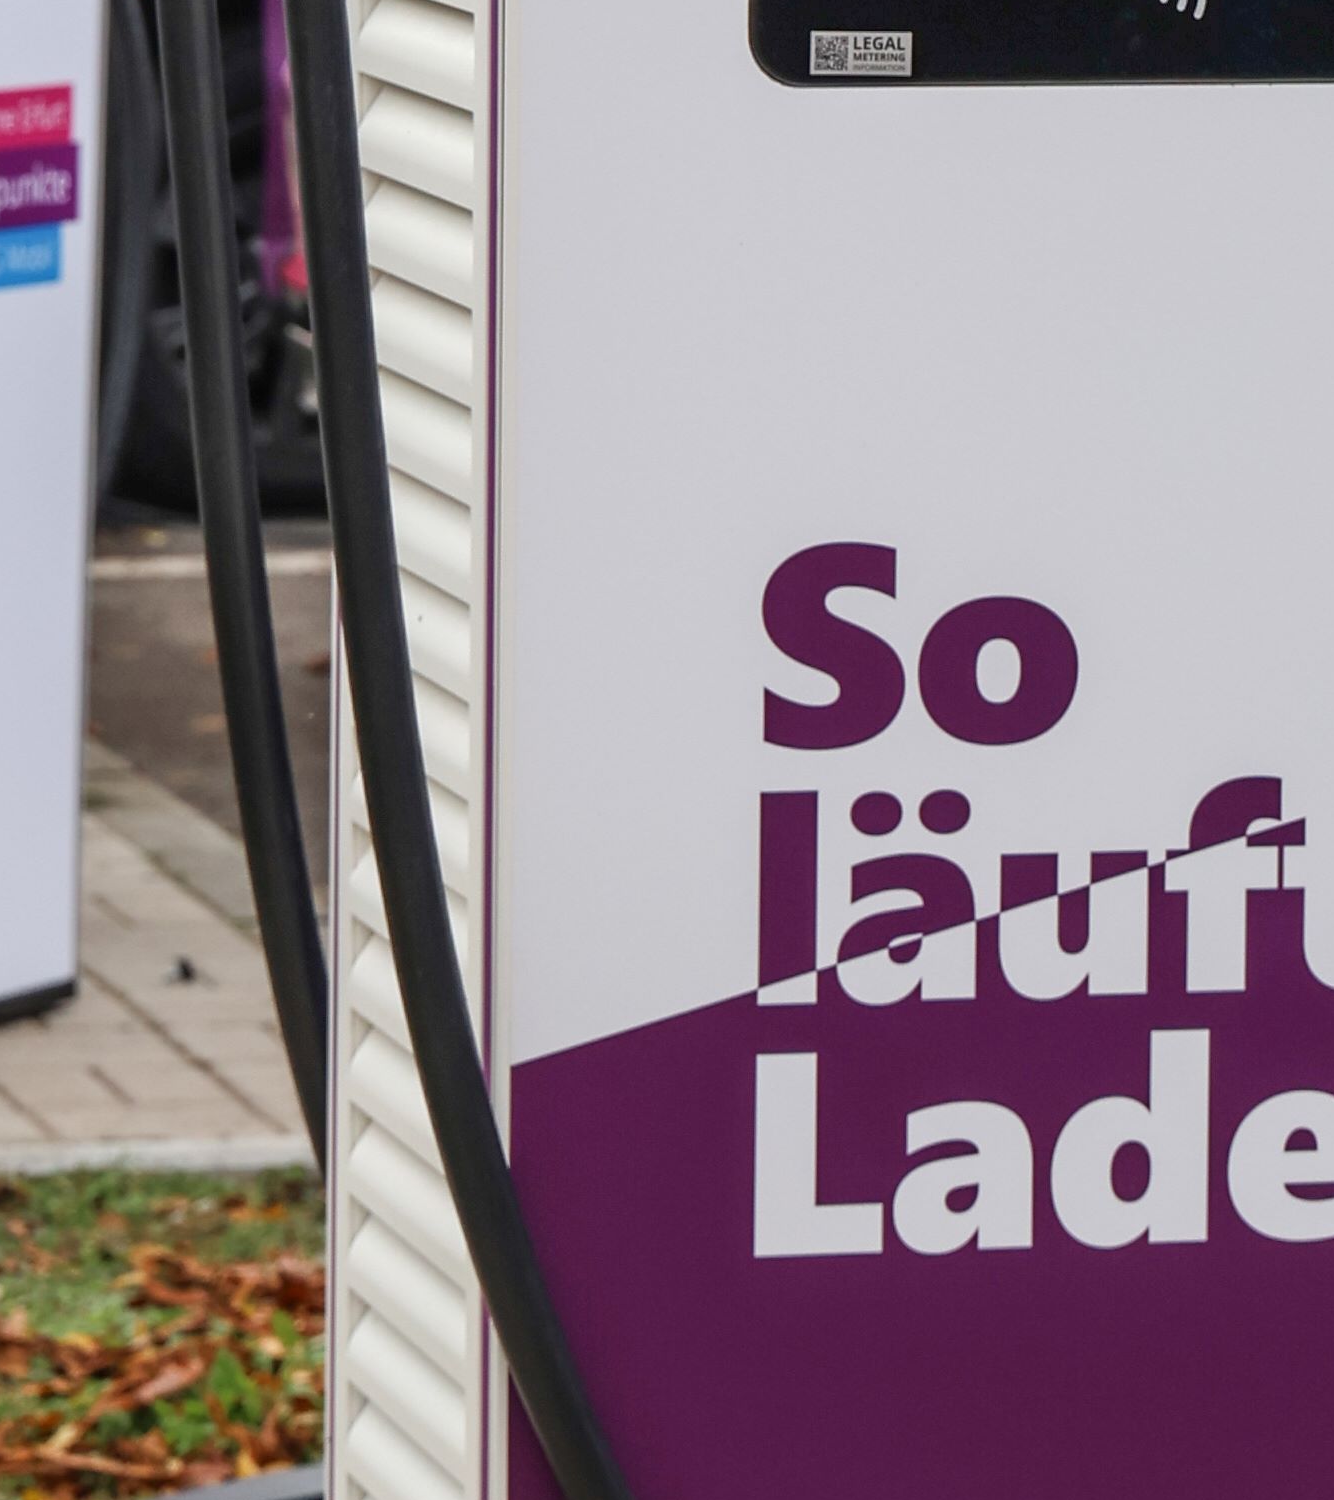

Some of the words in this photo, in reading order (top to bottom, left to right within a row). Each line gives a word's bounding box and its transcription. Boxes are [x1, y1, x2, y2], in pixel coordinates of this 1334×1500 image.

[853, 36, 906, 51] LEGAL
[853, 52, 906, 62] METERING
[761, 541, 1079, 751] So
